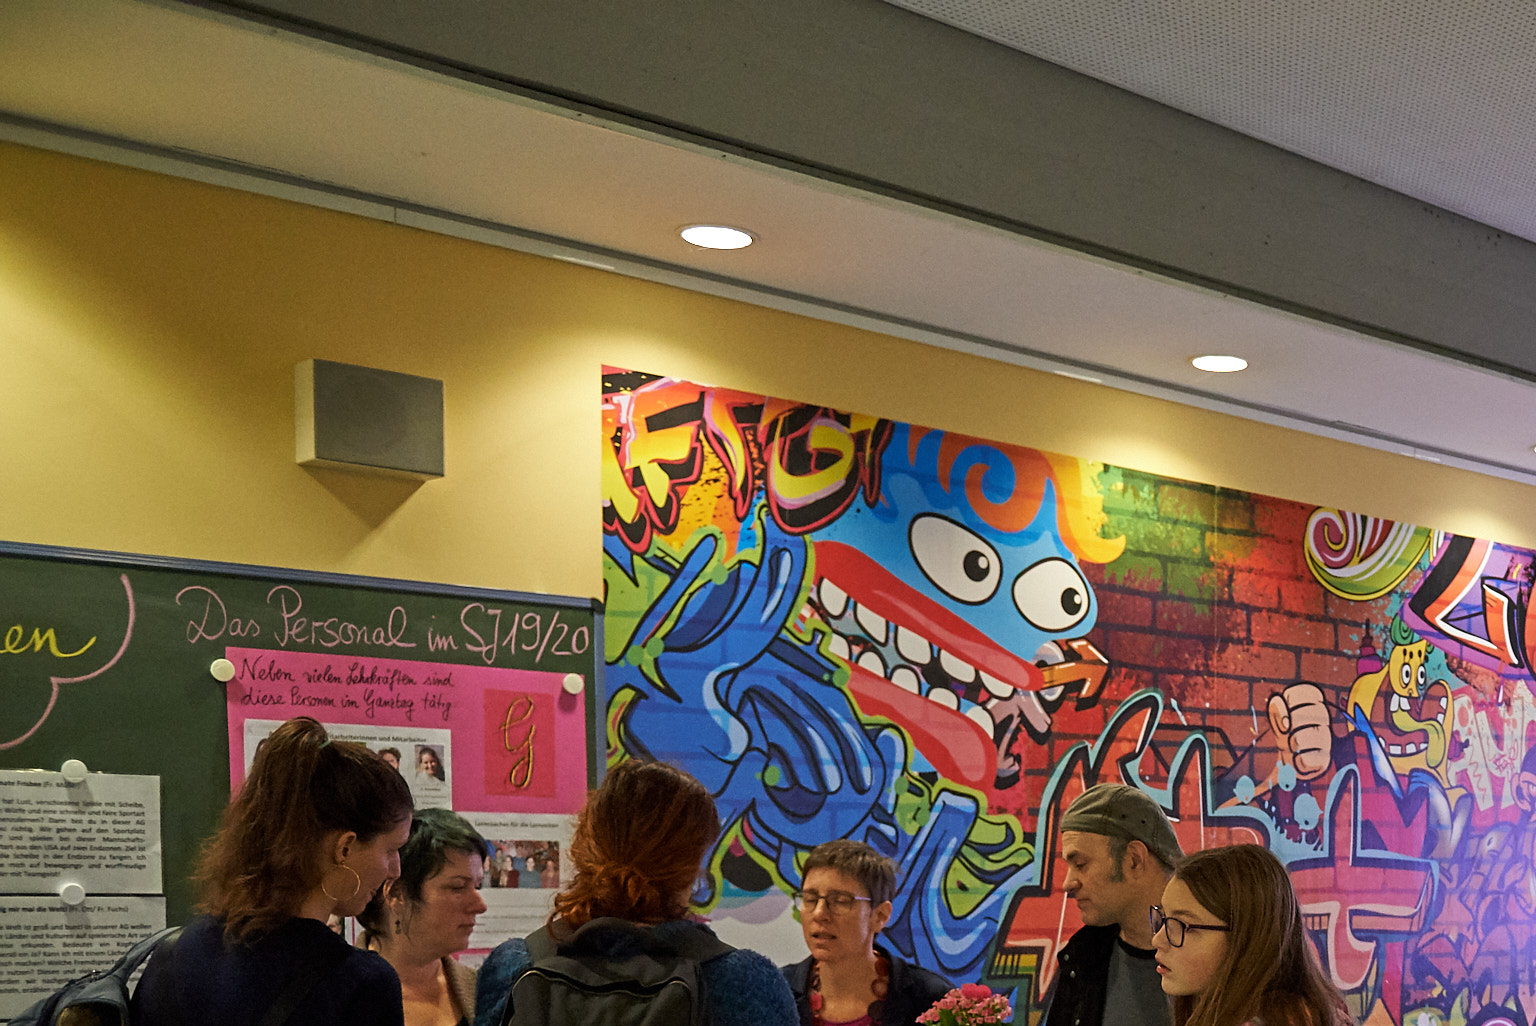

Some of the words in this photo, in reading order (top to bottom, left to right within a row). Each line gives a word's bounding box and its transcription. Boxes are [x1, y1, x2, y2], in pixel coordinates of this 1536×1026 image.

[176, 585, 260, 643] Das
[267, 585, 417, 646] Personal
[428, 615, 458, 652] im
[0, 624, 97, 657] en
[239, 655, 295, 682] Neben
[302, 669, 342, 684] vielen
[423, 672, 454, 687] sind
[240, 687, 285, 706] diese
[290, 686, 336, 706] Personen
[341, 694, 359, 709] im
